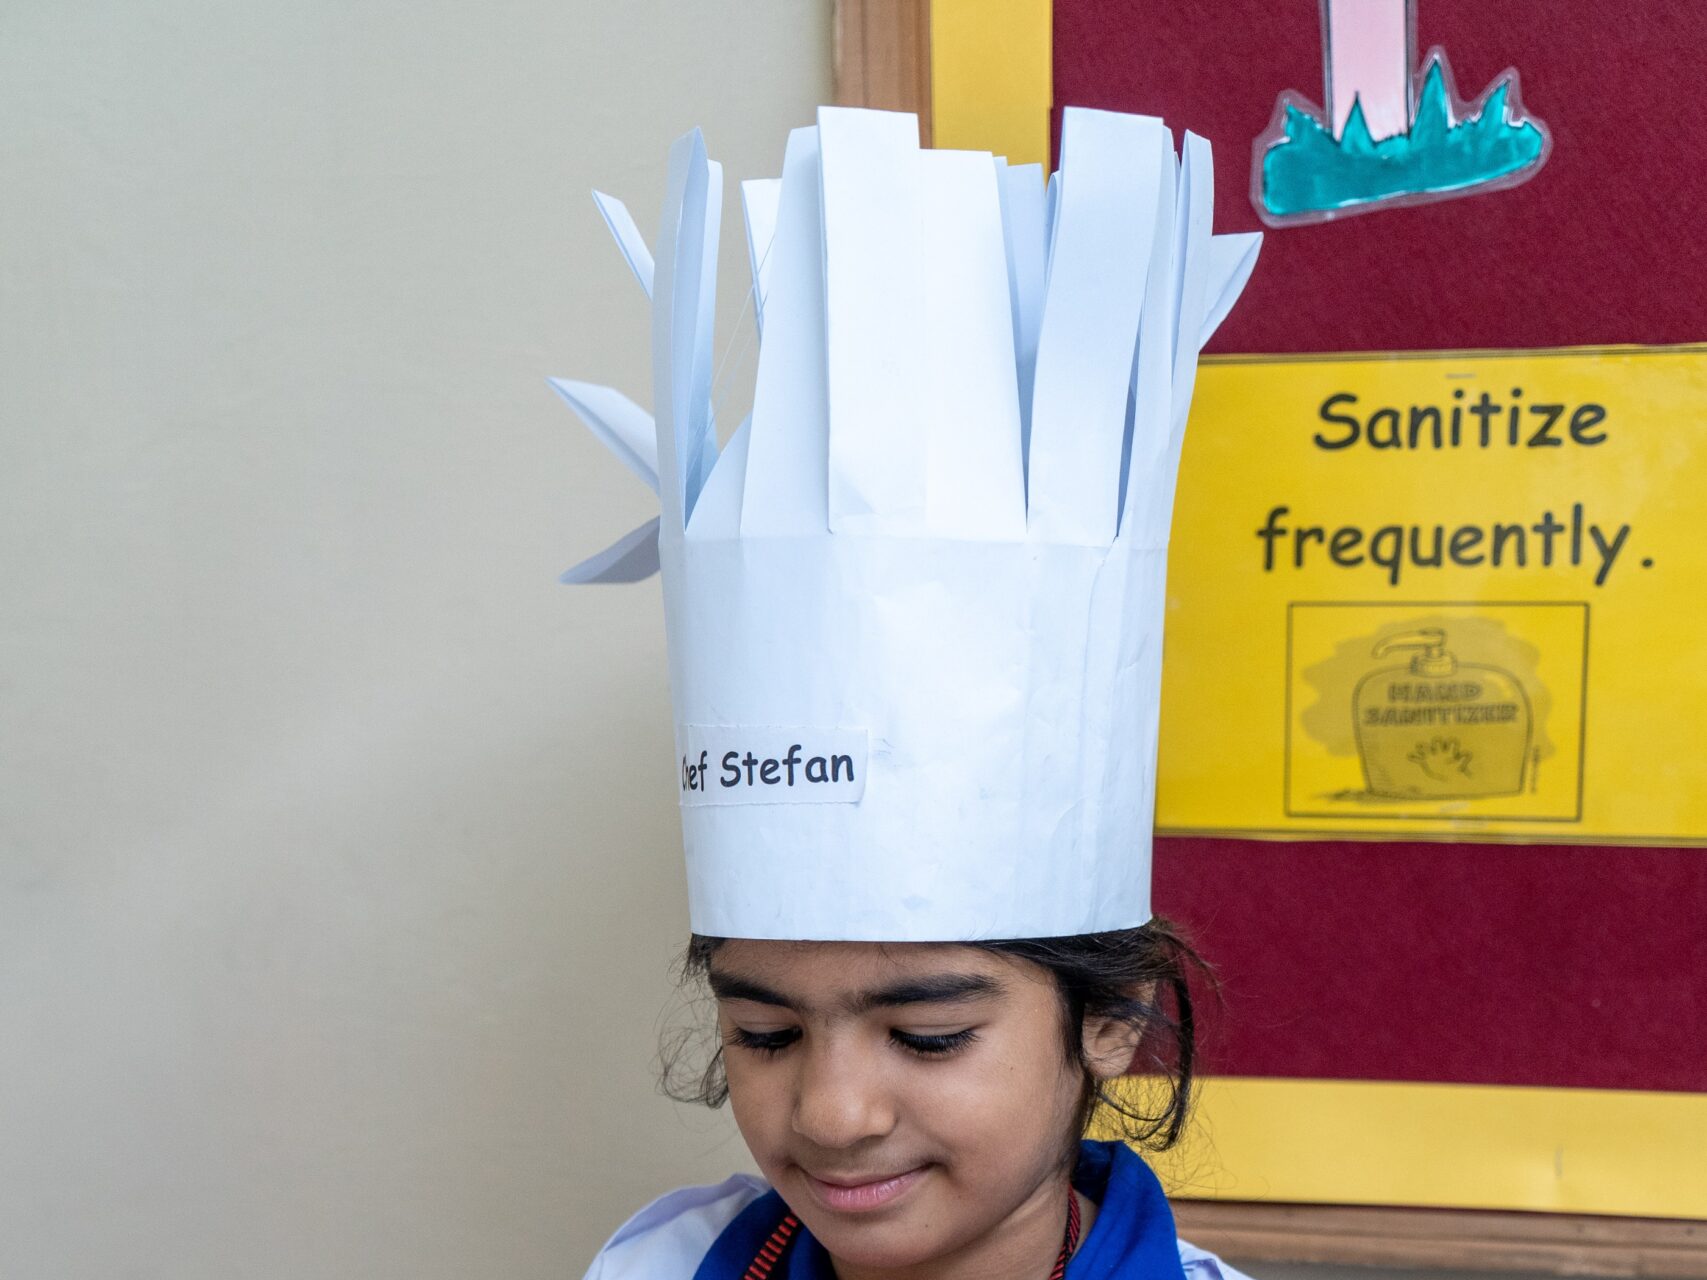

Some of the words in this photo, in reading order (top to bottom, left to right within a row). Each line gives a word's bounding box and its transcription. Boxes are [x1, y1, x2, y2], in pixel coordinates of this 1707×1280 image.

[1314, 387, 1608, 451] Sanitize
[1256, 502, 1654, 587] frequently.
[1388, 681, 1481, 701] HAND
[1364, 702, 1518, 725] SANITIZER
[720, 744, 854, 787] Stefan
